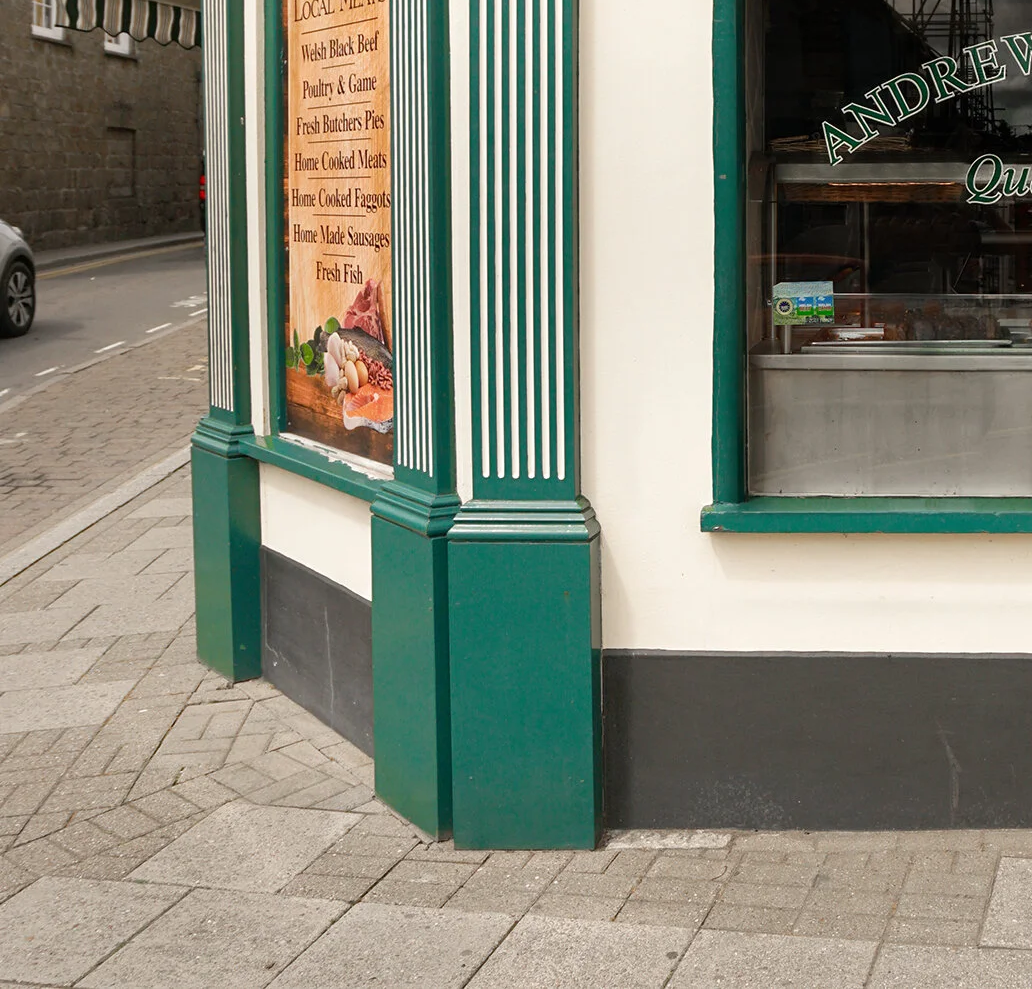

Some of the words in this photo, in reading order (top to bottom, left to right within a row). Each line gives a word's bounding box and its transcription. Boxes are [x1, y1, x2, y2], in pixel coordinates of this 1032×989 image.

[301, 41, 327, 62] Welsh
[329, 35, 355, 59] Black
[357, 30, 379, 53] Beef
[303, 78, 334, 101] Poultry
[337, 74, 345, 95] &
[348, 73, 377, 93] Game
[296, 115, 320, 136] Fresh
[323, 112, 362, 134] Butchers
[365, 109, 385, 130] Pies
[294, 152, 319, 172] Home
[321, 150, 355, 171] Cooked
[358, 149, 387, 169] Meats
[291, 188, 316, 207] Home
[318, 187, 352, 208] Cooked
[354, 187, 391, 214] Faggots
[293, 223, 318, 244] Home
[320, 224, 345, 245] Made
[347, 225, 390, 253] Sausages
[316, 260, 341, 282] Fresh
[343, 263, 363, 285] Fish
